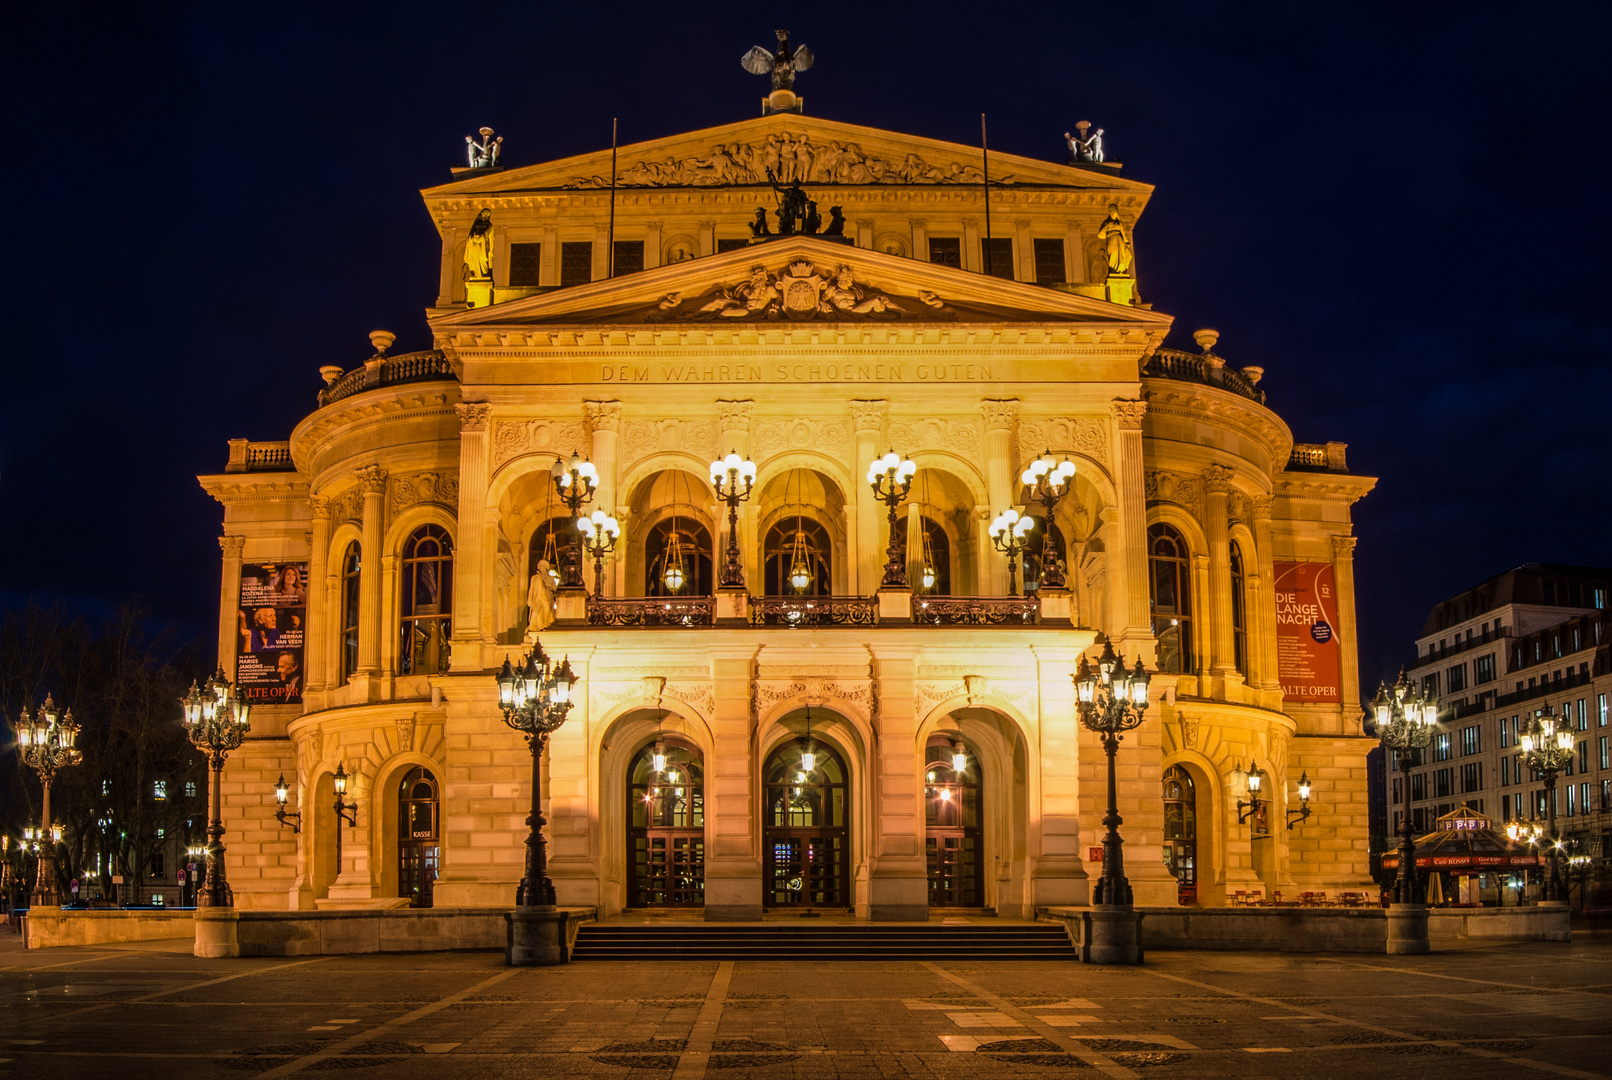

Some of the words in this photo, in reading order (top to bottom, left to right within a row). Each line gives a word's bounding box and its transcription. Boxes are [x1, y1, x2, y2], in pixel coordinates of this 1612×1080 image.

[601, 365, 649, 381] DEM
[660, 364, 762, 381] WAHREN
[776, 364, 901, 380] SCHOENEN
[1275, 593, 1296, 603] DIE
[1276, 603, 1318, 615] LANGE
[1277, 614, 1318, 625] NACHT
[248, 687, 268, 698] LTE
[1282, 685, 1308, 695] ALTE
[1309, 685, 1337, 696] OPER
